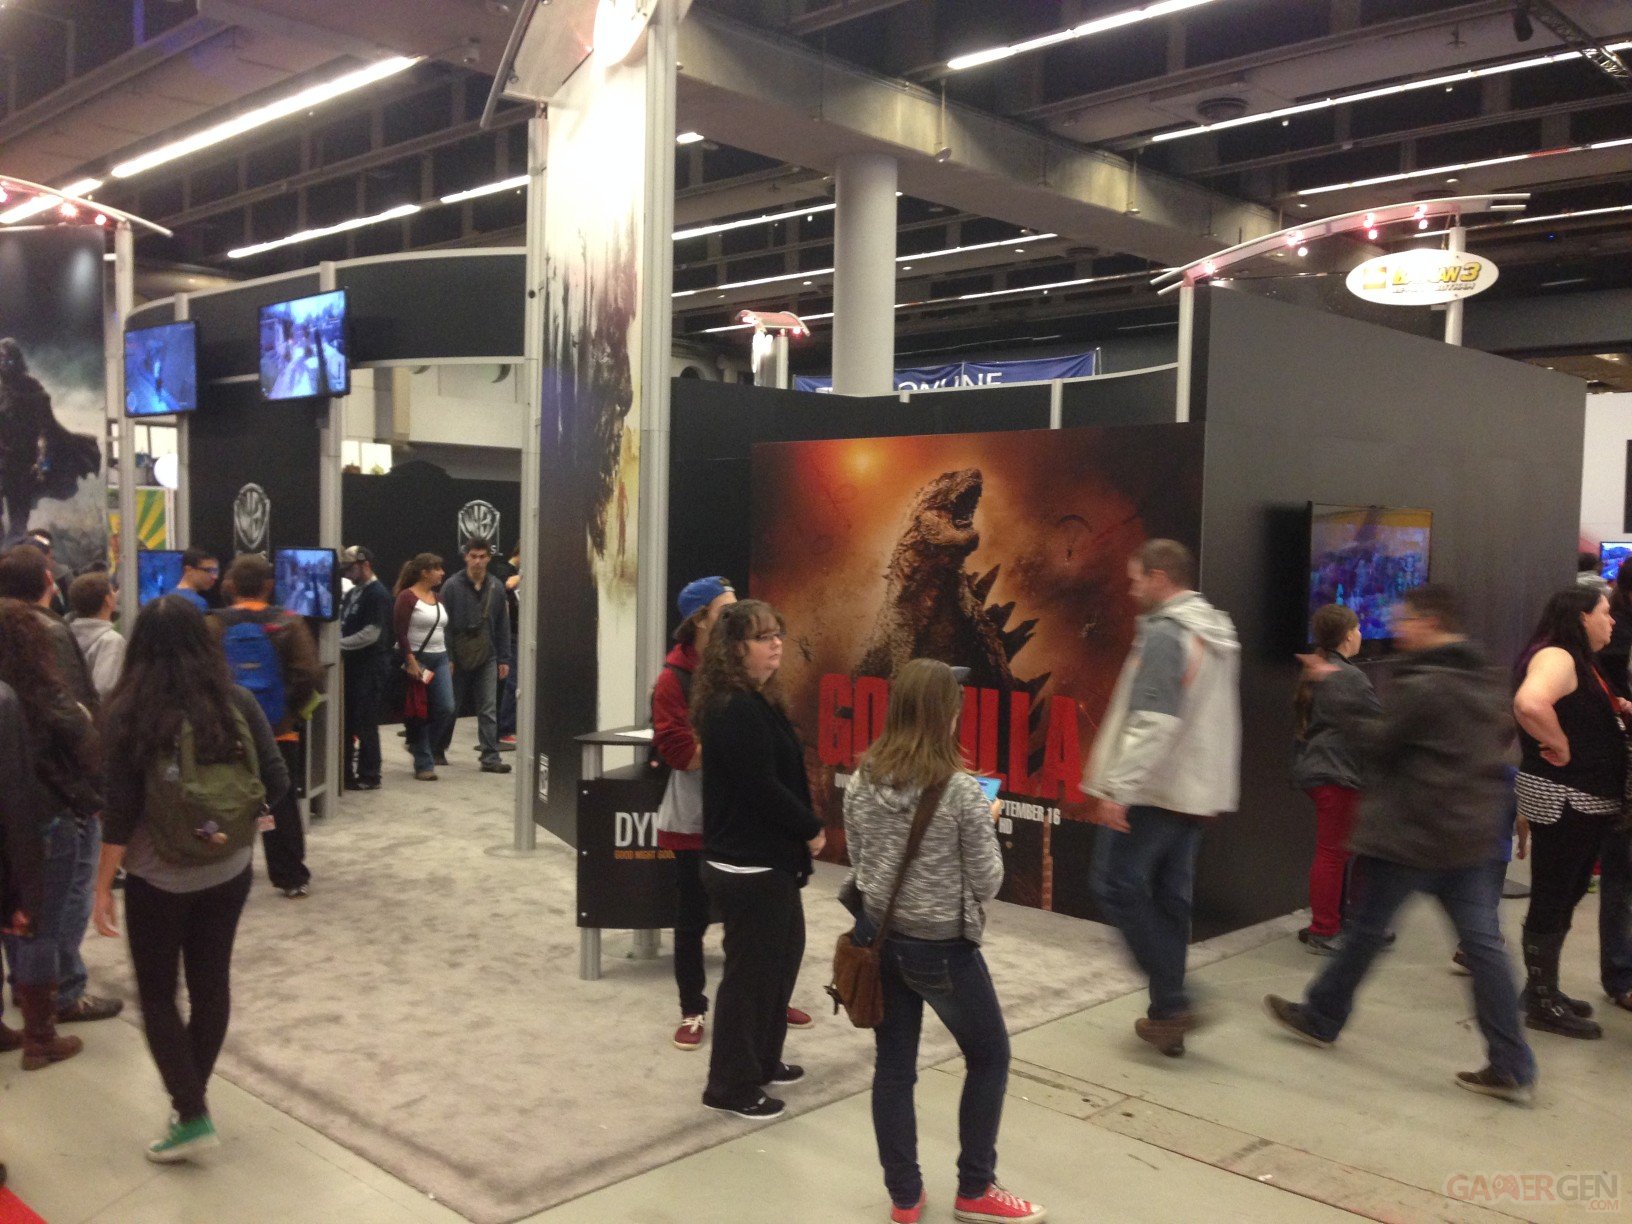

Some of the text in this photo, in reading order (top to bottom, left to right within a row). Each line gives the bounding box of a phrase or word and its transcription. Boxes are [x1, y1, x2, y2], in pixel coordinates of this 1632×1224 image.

[1460, 261, 1482, 282] 3
[818, 673, 1087, 804] GOILLA
[999, 800, 1044, 822] PTEMBER
